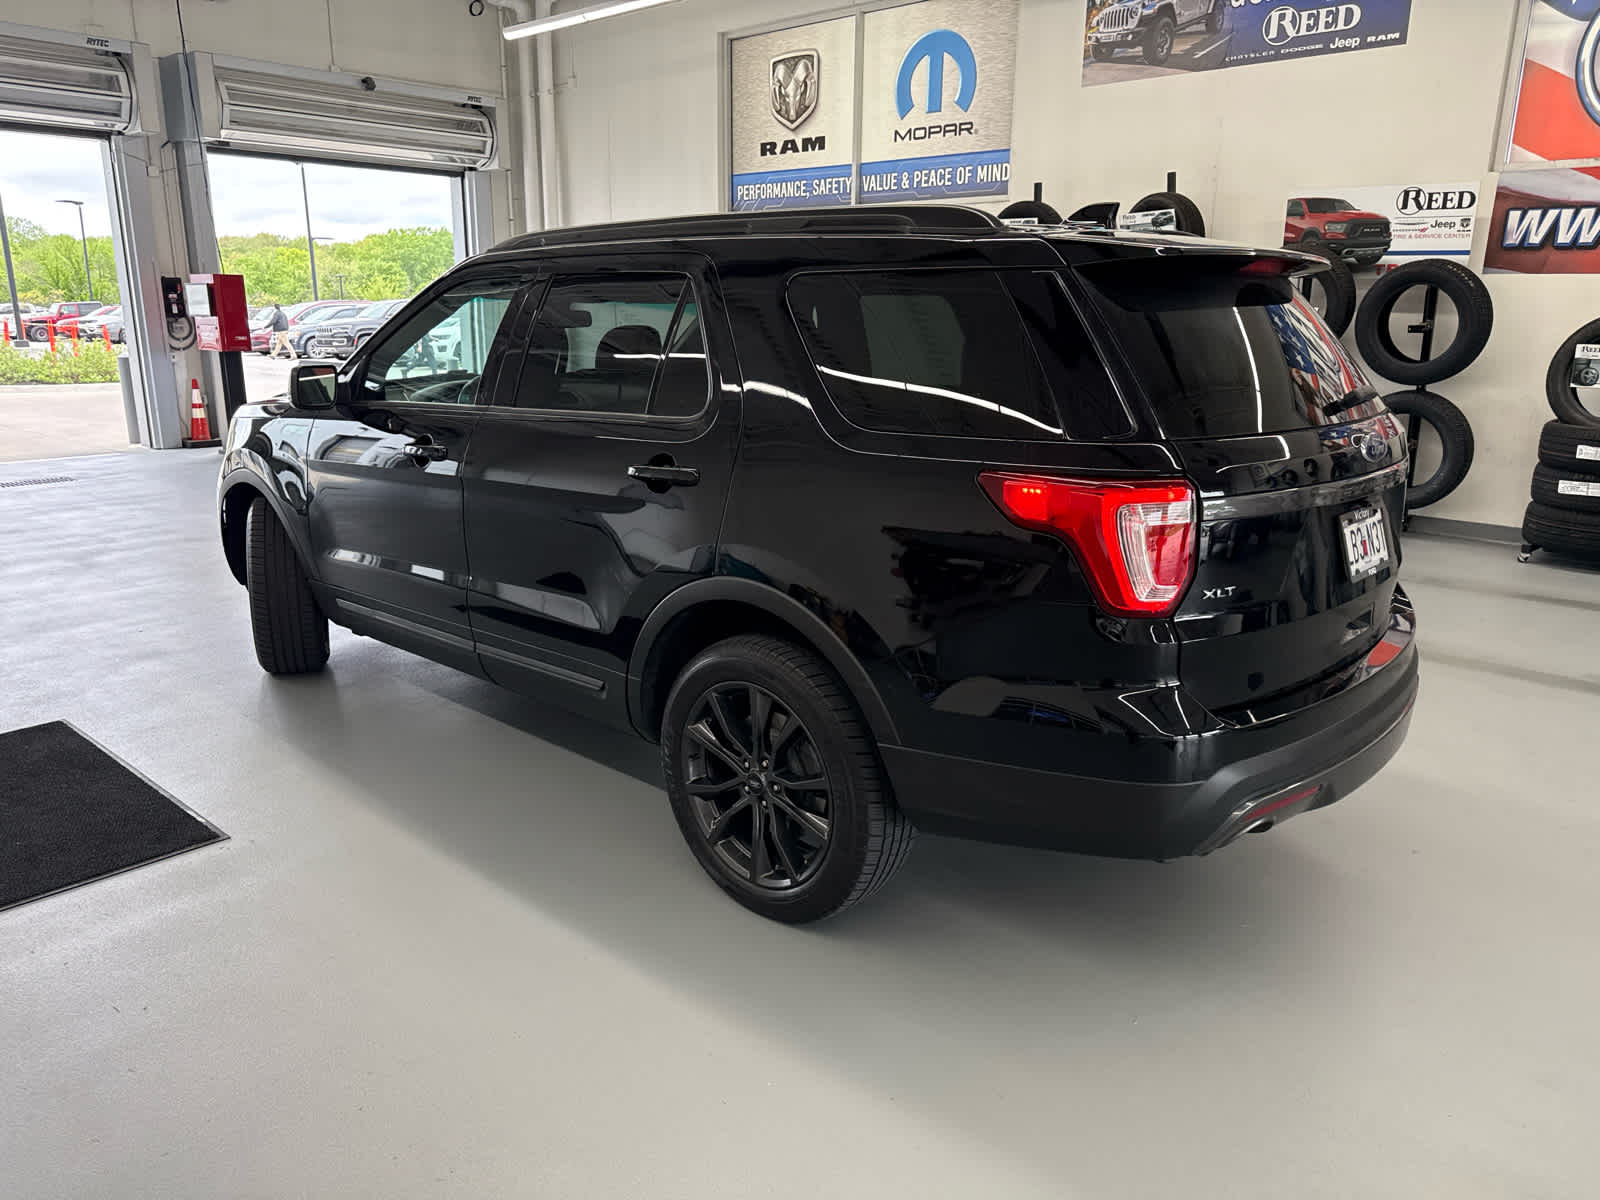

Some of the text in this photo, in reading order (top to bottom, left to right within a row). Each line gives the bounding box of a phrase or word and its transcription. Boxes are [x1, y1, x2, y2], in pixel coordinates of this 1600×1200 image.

[1263, 4, 1361, 45] REED
[1225, 32, 1400, 62] CHRYSLER DODGE Jeep RAM
[894, 121, 974, 142] MOPAR
[760, 136, 825, 156] RAM
[737, 163, 1009, 201] PERFORMANCE, SAFETY VALUE & PEACE OF MIND
[1396, 187, 1476, 215] REED
[1430, 219, 1456, 229] Jeep
[1202, 586, 1237, 599] XLT
